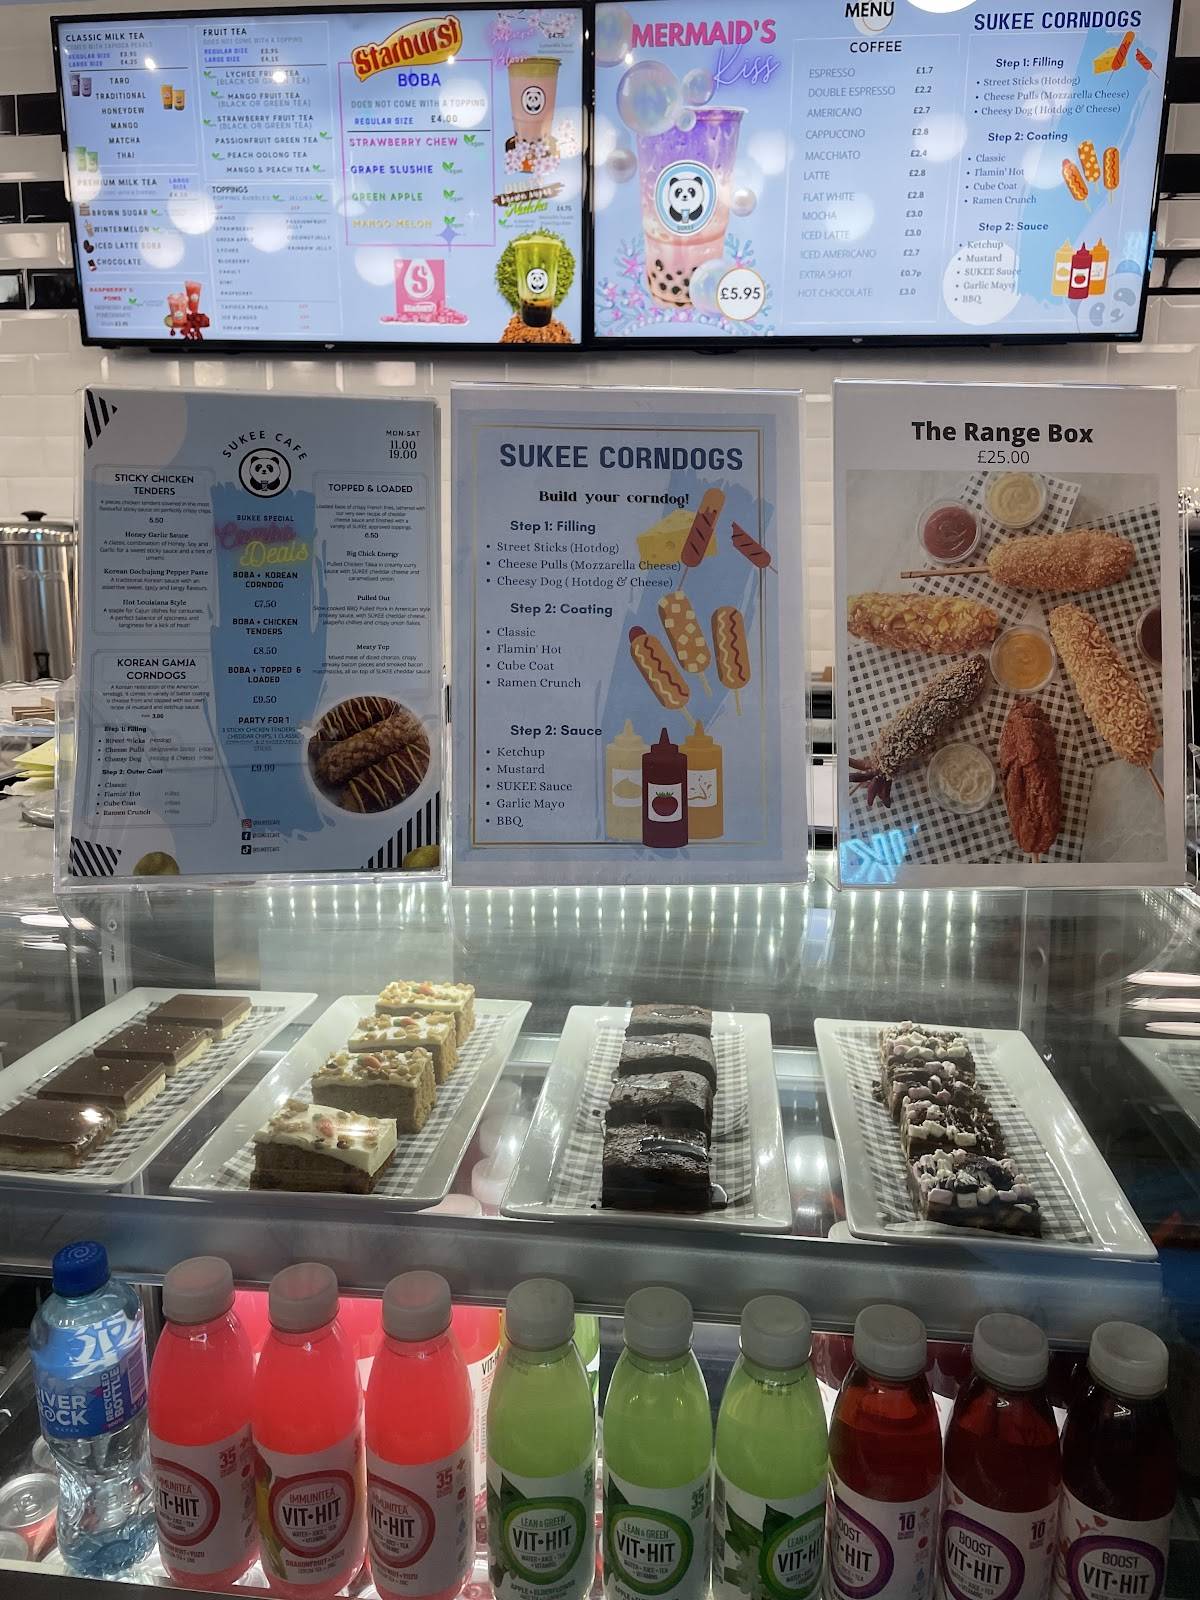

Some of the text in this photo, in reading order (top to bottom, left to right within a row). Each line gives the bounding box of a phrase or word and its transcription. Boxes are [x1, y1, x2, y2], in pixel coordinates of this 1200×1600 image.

[845, 0, 895, 18] MENU
[974, 10, 1142, 30] SUKEE CORNDOGS
[65, 33, 102, 42] CLASSIC
[129, 32, 144, 40] TEA
[203, 26, 247, 36] FRUIT TEA
[632, 19, 776, 48] MERMAID'S
[354, 18, 461, 77] Starburst
[850, 40, 902, 53] COFFEE
[713, 44, 782, 85] Kiss
[995, 56, 1064, 70] Step 1: Filling
[809, 68, 856, 78] ESPRESSO
[916, 66, 934, 74] £1.7
[398, 73, 441, 87] BOBA
[983, 75, 1081, 88] Street Sticks (Hotdog)
[808, 85, 896, 97] DOUBLE ESPRESSO
[915, 85, 932, 94] £2.2
[96, 92, 146, 101] TRADITIONAL
[101, 107, 144, 115] HONEYDEW
[806, 107, 862, 117] AMERICANO
[913, 106, 931, 114] £2.7
[215, 136, 271, 144] PASSIONFRUIT
[274, 136, 300, 144] GREEN
[349, 137, 458, 147] STRAWBERRY CHEW
[988, 131, 1068, 144] Step 2: Coating
[975, 152, 1006, 163] Classic
[350, 165, 433, 174] GRAPE SLUSHIE
[212, 185, 248, 194] TOPPINGS
[973, 181, 1017, 191] Cube Coat
[351, 192, 423, 202] GREEN APPLE
[972, 195, 1037, 205] Ramen Crunch
[978, 221, 1049, 234] Step 2: Sauce
[720, 285, 761, 300] £5.95
[911, 420, 1093, 448] The Range Box
[222, 430, 308, 461] SUKEE CAFE
[389, 440, 416, 450] 11.00
[389, 450, 417, 460] 19.00
[500, 443, 743, 471] SUKEE CORNDOGS
[977, 450, 1030, 464] £25.00
[115, 473, 194, 485] STICKY CHICKEN
[133, 486, 176, 496] TENDERS
[328, 483, 413, 495] TOPPED & LOADED
[539, 490, 689, 509] Build your corndog!
[236, 514, 294, 522] SUKEE SPECIAL
[510, 520, 596, 535] Step 1: Filling
[497, 541, 619, 556] Street Sticks (Hotdog)
[498, 558, 682, 571] Cheese Pulls (Mozzarella Cheese)
[233, 571, 255, 579] BOBA
[264, 571, 298, 580] KOREAN
[245, 580, 284, 588] CORNDOG
[497, 575, 537, 588] Cheesy
[540, 577, 564, 589] Dog
[572, 576, 614, 589] Hotdog
[616, 576, 628, 587] &
[630, 578, 673, 590] Cheese)
[254, 599, 278, 608] £7.50
[510, 602, 613, 618] Step 2: Coating
[497, 626, 536, 638] Classic
[253, 646, 277, 656] £8.50
[497, 644, 561, 655] Flamin' Hot
[117, 656, 197, 667] KOREAN GAMJA
[497, 660, 554, 671] Cube Coat
[126, 671, 186, 680] CORNDOGS
[496, 677, 581, 688] Ramen Crunch
[238, 716, 266, 724] PARTY
[267, 716, 284, 724] FOR
[510, 724, 602, 739] Step 2: Sauce
[497, 746, 545, 759] Ketchup
[497, 763, 545, 776] Mustard
[497, 781, 572, 792] SUKEE Sauce
[496, 797, 565, 811] Garlic Mayo
[497, 816, 524, 829] BBQ
[110, 1367, 124, 1419] BOTTLE
[959, 1531, 993, 1558] BOOST
[1102, 1552, 1139, 1569] BOOST
